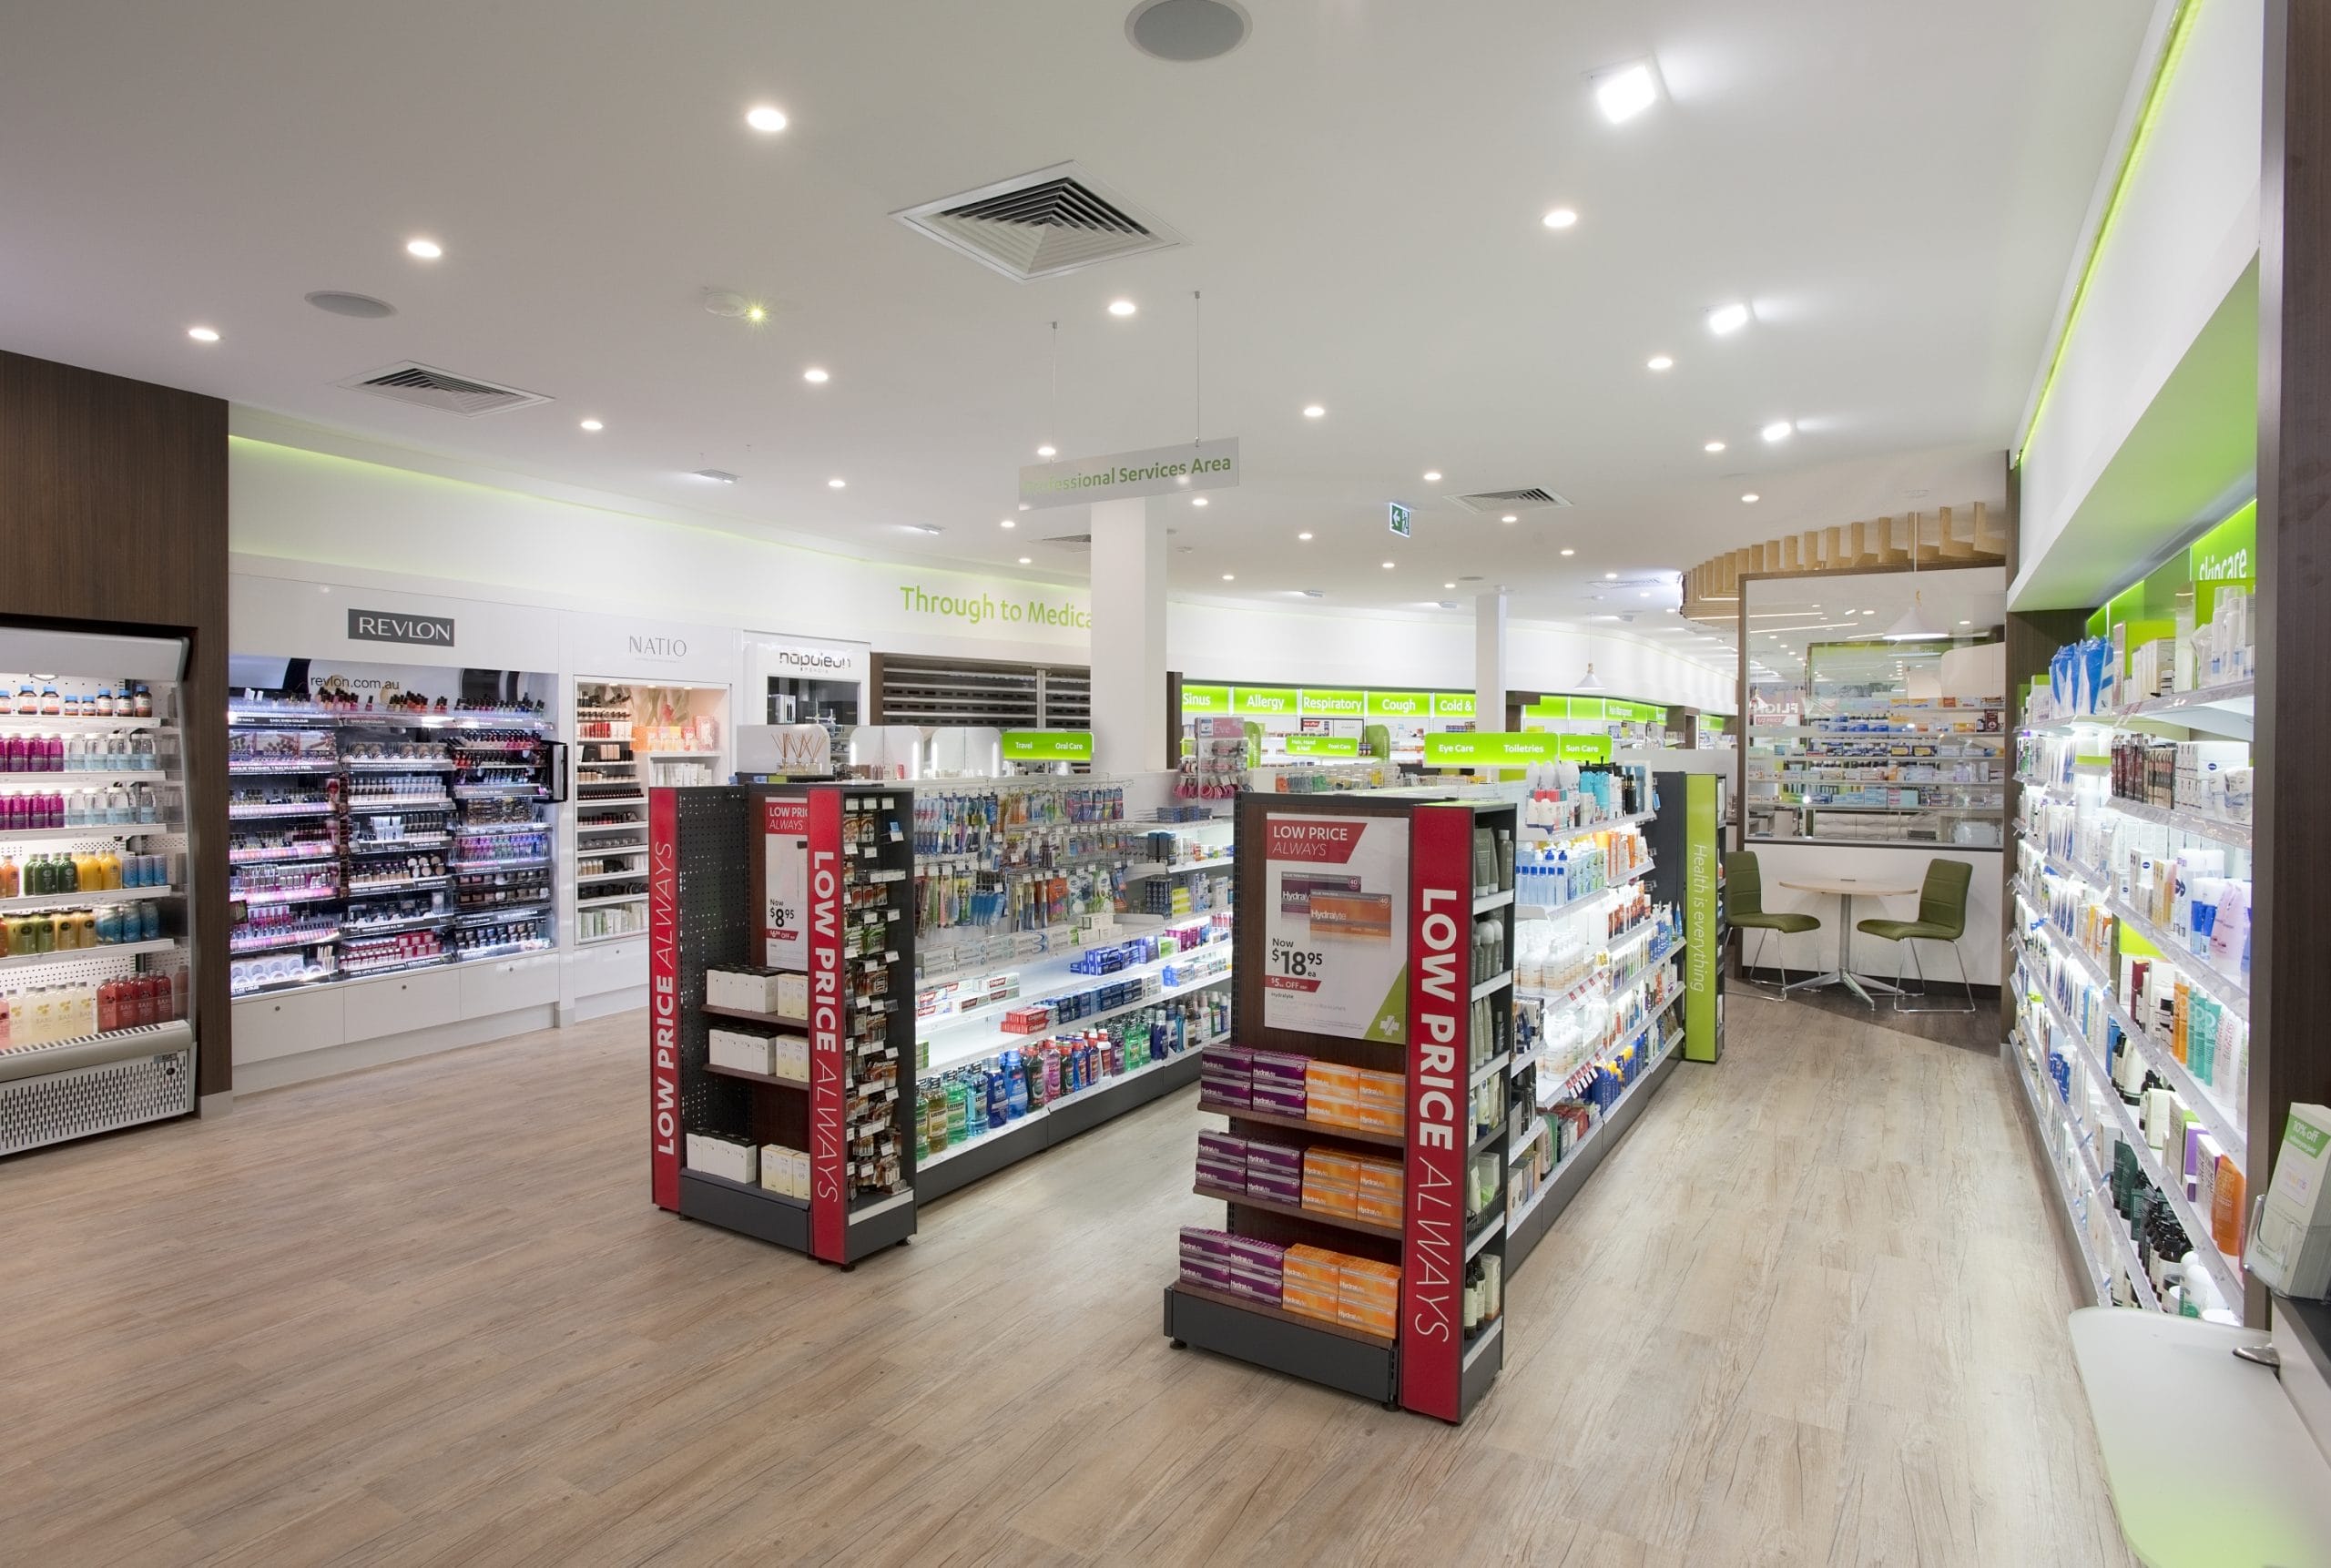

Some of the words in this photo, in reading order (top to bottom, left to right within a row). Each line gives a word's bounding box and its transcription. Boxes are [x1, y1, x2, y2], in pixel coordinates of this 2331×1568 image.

[1119, 462, 1186, 484] Services
[1191, 457, 1231, 474] Area
[900, 585, 994, 625] Through
[1001, 599, 1022, 622] to
[359, 616, 451, 642] REVLON
[629, 635, 687, 657] NATIO
[310, 675, 400, 691] revlon.com.au
[1182, 693, 1211, 707] Sinus
[1247, 694, 1285, 711] Allergy
[1303, 697, 1362, 711] Respiratory
[1381, 697, 1416, 714] Cough
[1440, 699, 1461, 712] Cold
[1462, 700, 1472, 712] &
[1015, 741, 1033, 749] Travel
[1055, 742, 1068, 750] Oral
[1069, 742, 1084, 750] Care
[1439, 744, 1454, 754] Eye
[1455, 744, 1474, 753] Care
[1503, 744, 1544, 754] Toiletries
[1566, 744, 1580, 753] Sun
[1581, 745, 1599, 753] Care
[769, 807, 790, 817] LOW
[769, 820, 803, 831] ALWAYS
[1273, 826, 1306, 840] LOW
[1308, 828, 1348, 841] PRICE
[1272, 842, 1327, 857] ALWAYS
[1694, 844, 1709, 893] Health
[813, 850, 835, 939] LOW
[656, 841, 672, 970] ALWAYS
[1694, 898, 1707, 909] is
[1311, 910, 1347, 921] Hydralyte
[1272, 937, 1294, 948] Now
[1421, 889, 1457, 1003] LOW
[1690, 911, 1708, 993] everything
[814, 948, 837, 1053] PRICE
[657, 974, 674, 1070] PRICE
[1419, 1013, 1456, 1151] PRICE
[657, 1076, 674, 1156] LOW
[816, 1058, 838, 1203] ALWAYS
[2293, 1120, 2307, 1137] 10%
[2306, 1129, 2320, 1143] off
[1415, 1157, 1451, 1343] ALWAYS
